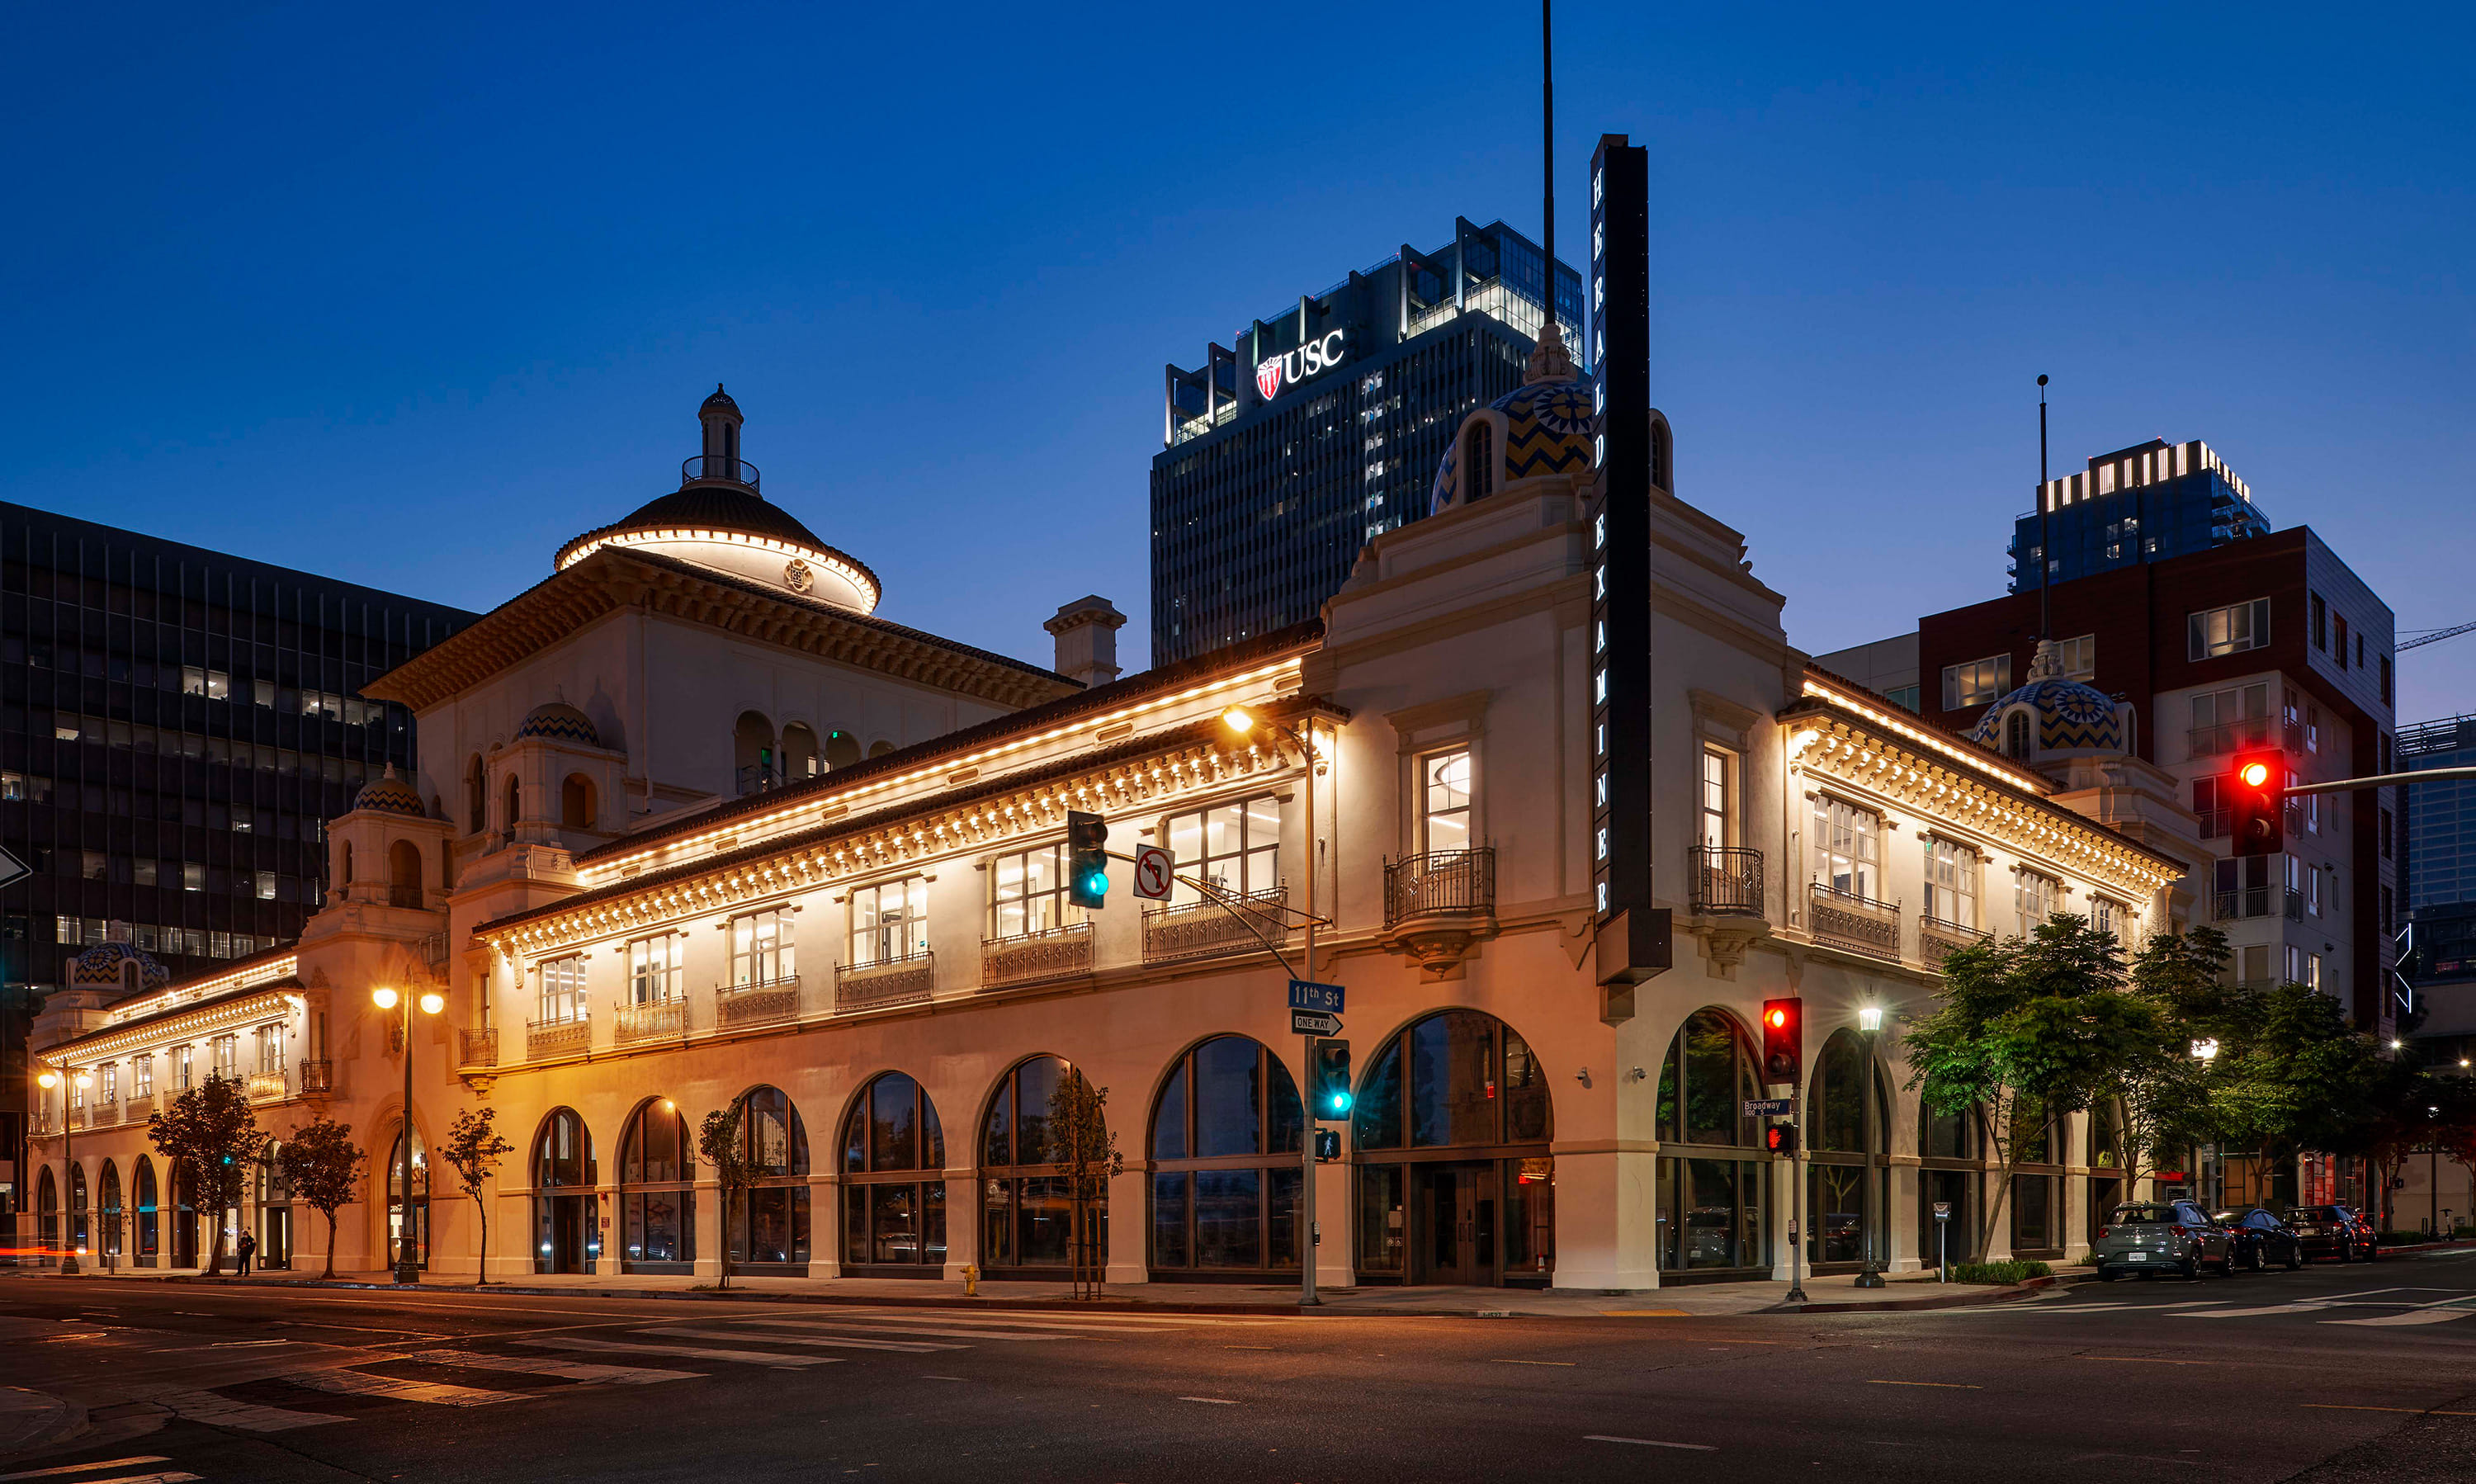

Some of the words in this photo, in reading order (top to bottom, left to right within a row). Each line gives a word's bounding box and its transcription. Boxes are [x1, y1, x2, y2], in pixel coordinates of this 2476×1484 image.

[1593, 168, 1604, 469] HERALD
[1283, 328, 1344, 384] USC
[1595, 513, 1607, 914] EXAMINER
[1295, 985, 1319, 1004] 11th
[1325, 991, 1339, 1006] St
[1297, 1017, 1312, 1028] ONE
[1314, 1018, 1329, 1029] WAY
[1744, 1101, 1780, 1111] Broadway
